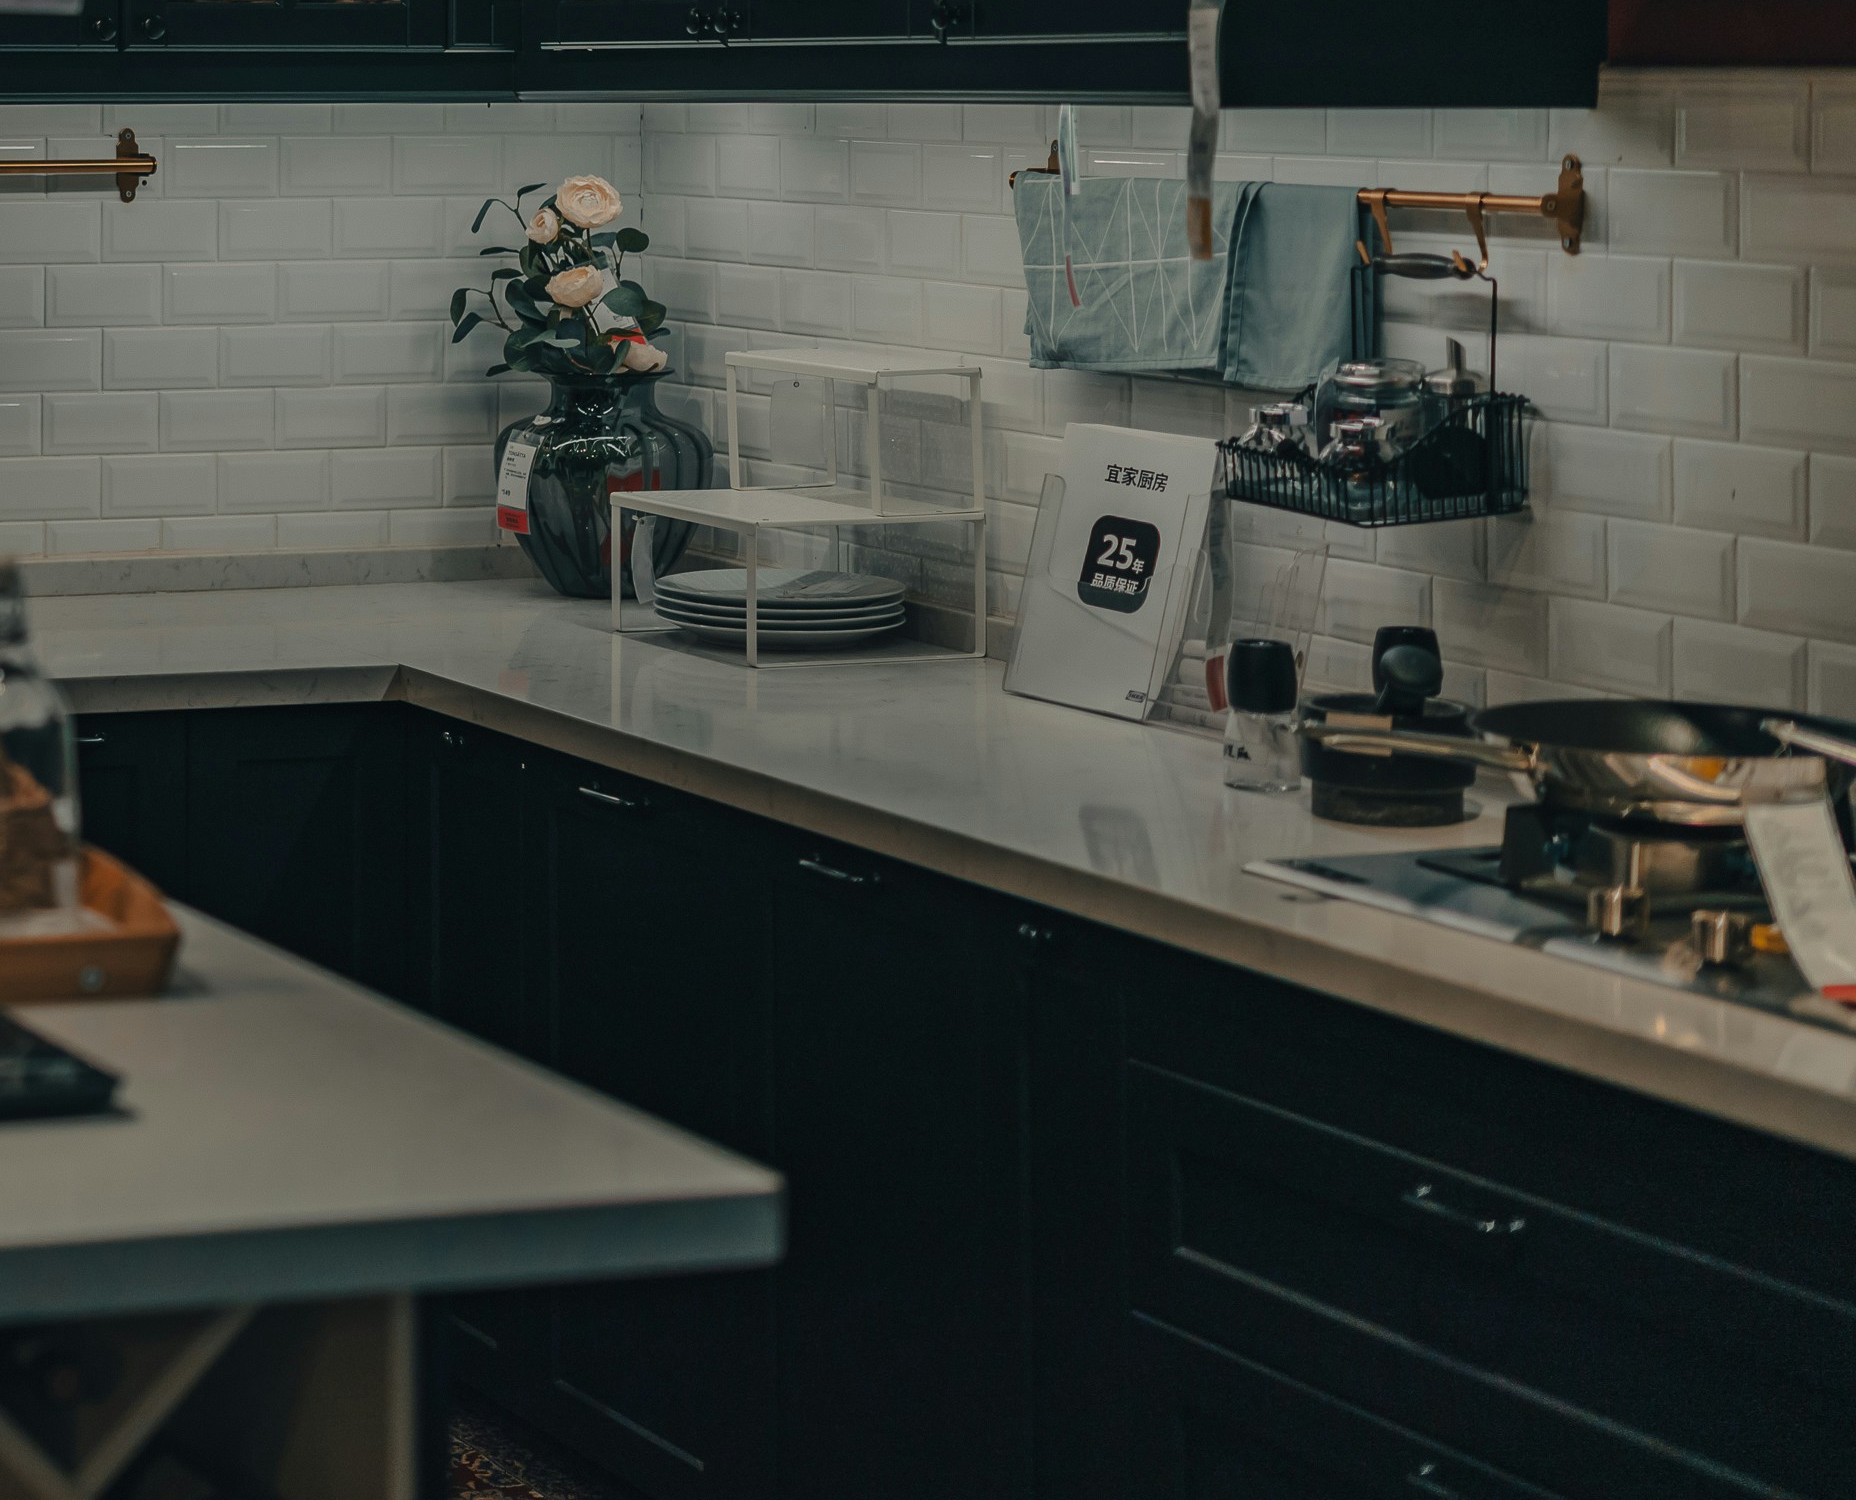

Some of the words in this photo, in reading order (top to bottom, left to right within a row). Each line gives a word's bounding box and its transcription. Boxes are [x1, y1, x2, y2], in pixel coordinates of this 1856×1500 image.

[1104, 463, 1169, 493] 宜家厨房
[1089, 572, 1140, 596] 品质保证
